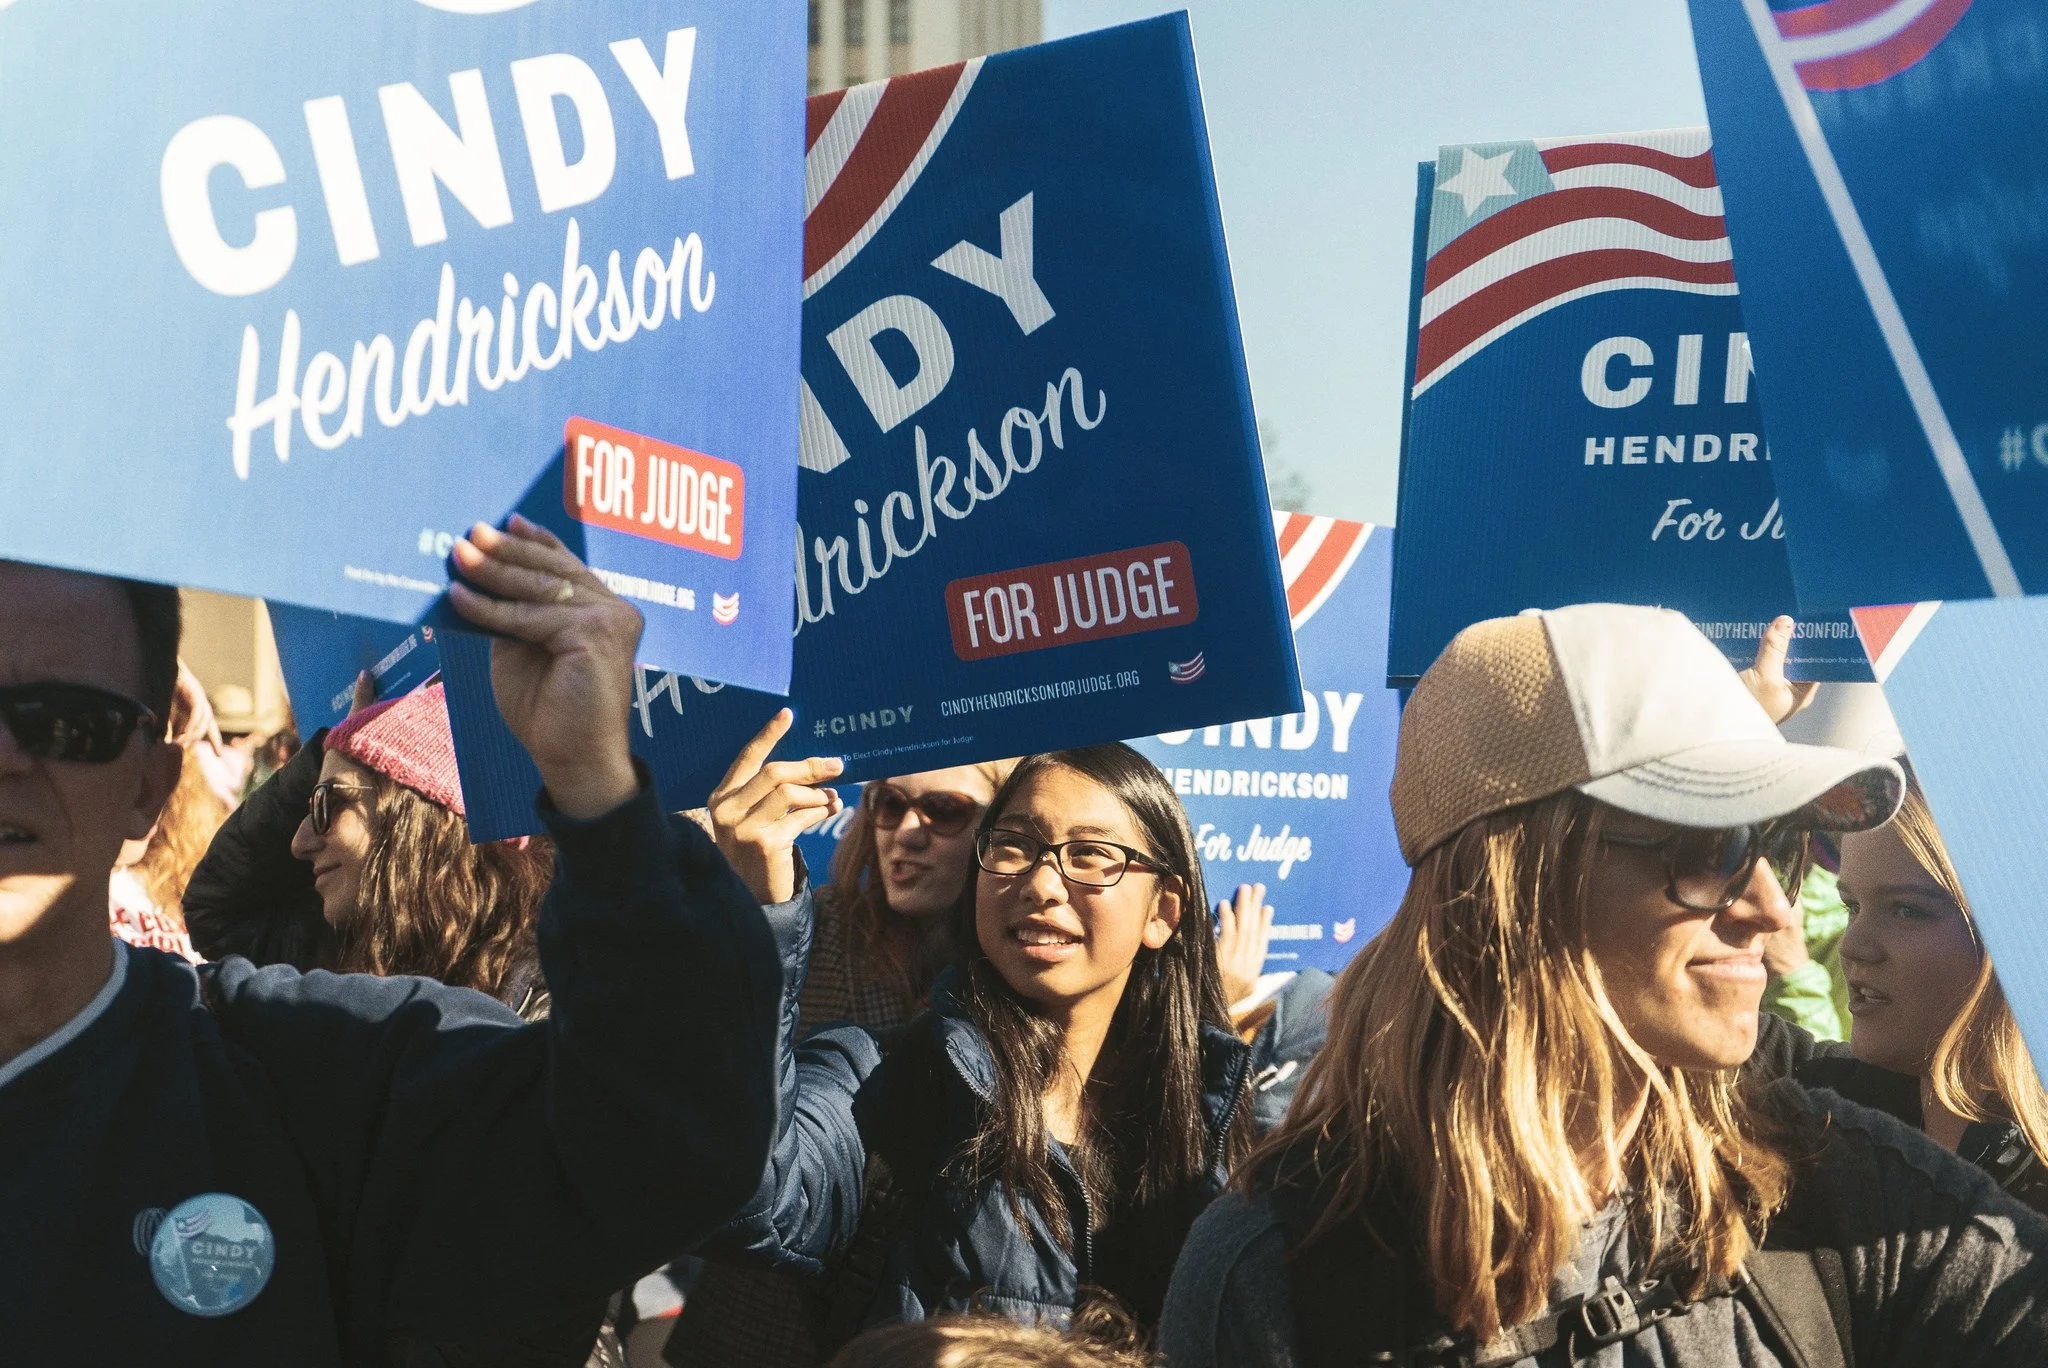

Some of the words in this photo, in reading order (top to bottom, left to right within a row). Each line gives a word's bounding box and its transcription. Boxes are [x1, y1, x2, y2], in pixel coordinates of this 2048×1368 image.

[159, 26, 697, 297] CINDY
[226, 216, 715, 481] Hendrickson
[1584, 433, 1771, 465] HENDR
[576, 433, 636, 520] FOR
[640, 454, 733, 545] JUDGE
[1651, 498, 1725, 541] For
[963, 582, 1041, 648] FOR
[1053, 556, 1180, 634] JUDGE
[941, 670, 1140, 717] CINDYHENDRICKSONFORJUDGE.ORG
[813, 705, 914, 738] #CINDY
[842, 754, 852, 762] To
[853, 751, 871, 760] Elect
[872, 748, 893, 757] Cindy
[894, 740, 940, 753] Hendrickson
[1195, 823, 1232, 861] For
[1236, 823, 1313, 880] Judge
[191, 1240, 257, 1258] CINDY
